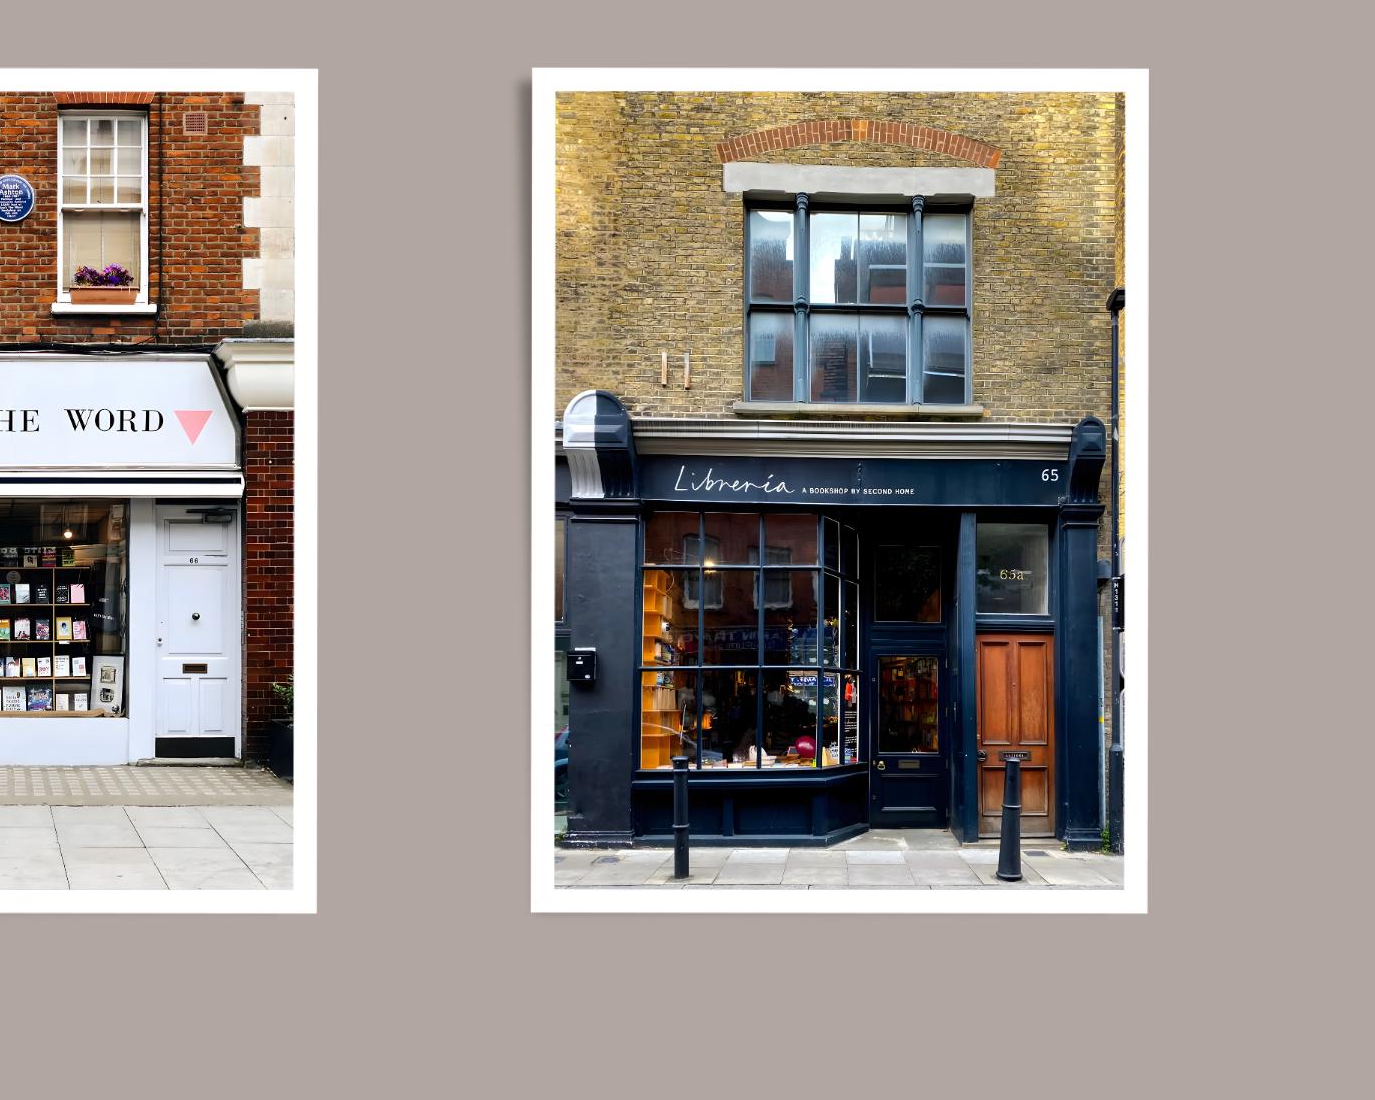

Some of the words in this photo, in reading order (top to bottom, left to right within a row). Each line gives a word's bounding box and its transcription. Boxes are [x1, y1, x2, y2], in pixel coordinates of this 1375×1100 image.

[63, 408, 165, 433] WORD
[1041, 468, 1059, 482] 65
[999, 569, 1024, 581] 65a
